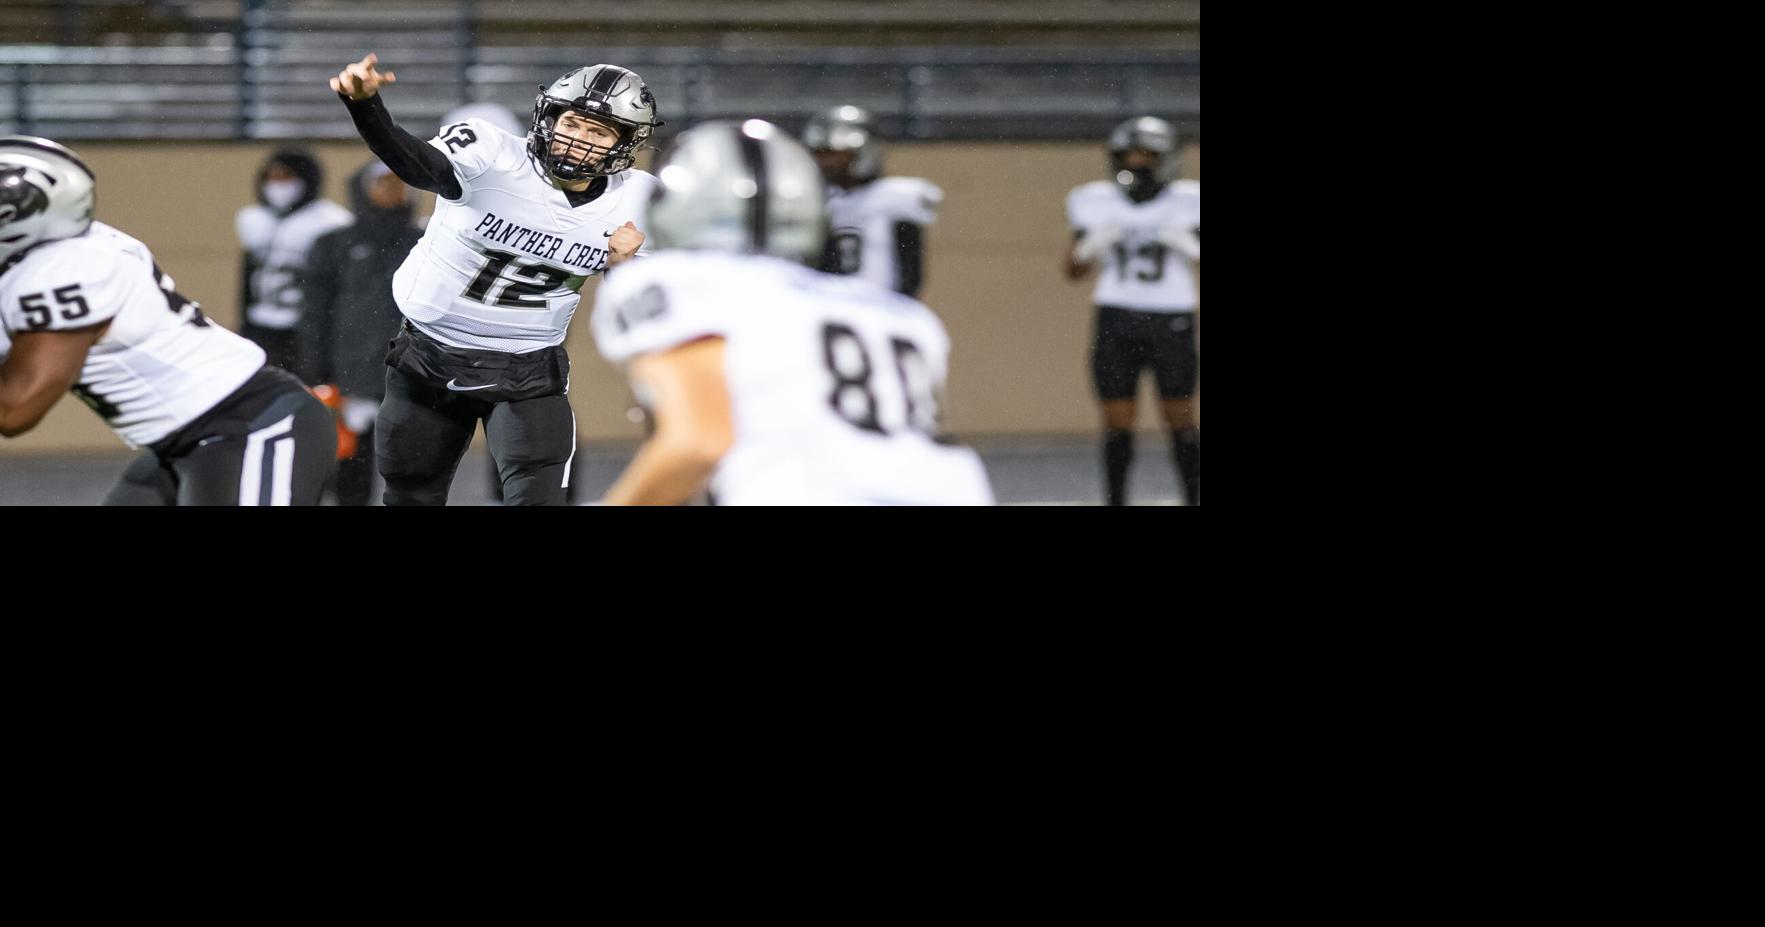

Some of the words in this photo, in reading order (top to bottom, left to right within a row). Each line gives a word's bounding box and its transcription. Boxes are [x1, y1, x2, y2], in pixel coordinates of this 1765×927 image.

[474, 212, 563, 260] PANTHER
[562, 242, 609, 271] CREE
[18, 282, 91, 331] 55
[460, 247, 571, 310] 12
